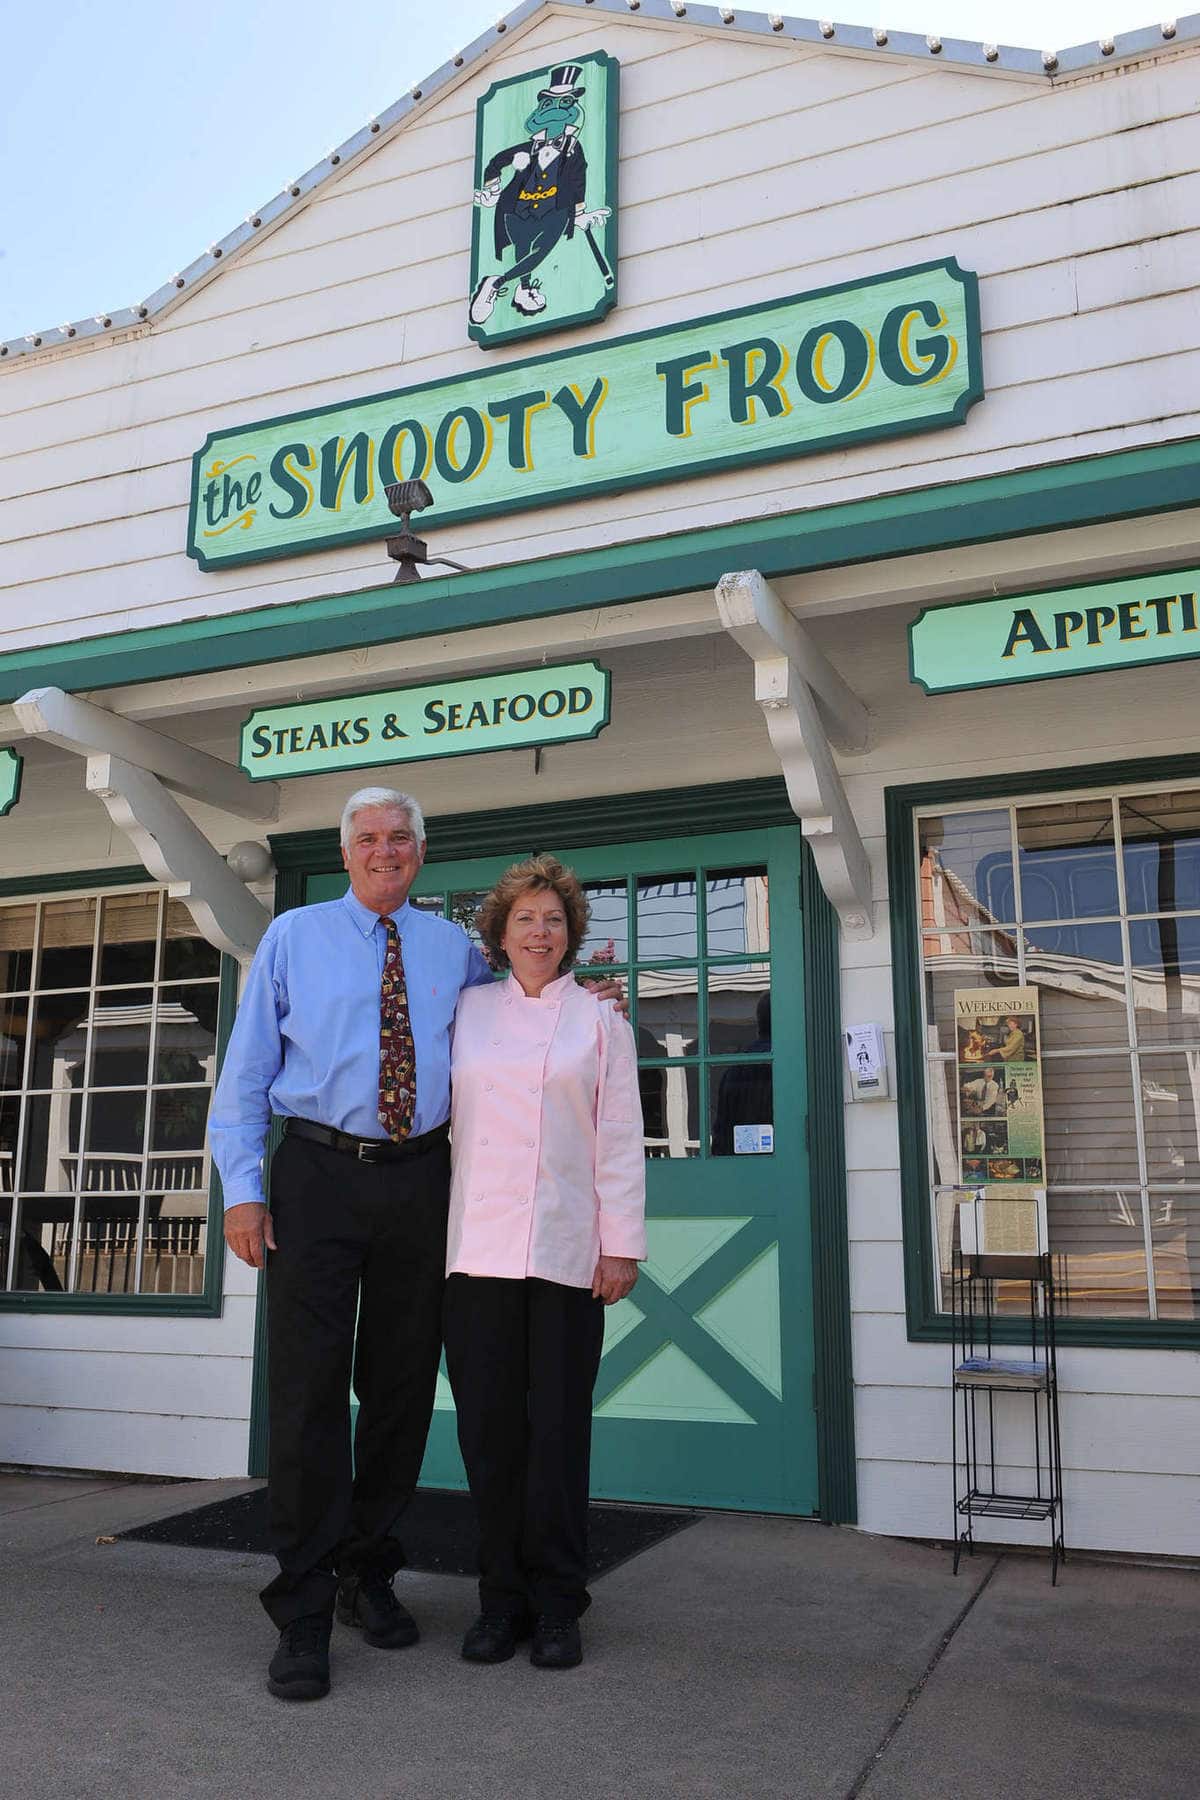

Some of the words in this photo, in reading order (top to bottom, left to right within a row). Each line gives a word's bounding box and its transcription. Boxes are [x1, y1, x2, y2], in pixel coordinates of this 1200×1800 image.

[202, 471, 262, 526] the
[269, 376, 608, 519] SNOOTY
[656, 299, 958, 438] FROG
[1000, 592, 1198, 659] APPETI
[251, 717, 371, 759] STEAKS
[381, 713, 410, 741] &
[423, 686, 594, 736] SEAFOOD
[958, 1000, 1022, 1014] WEEKEND
